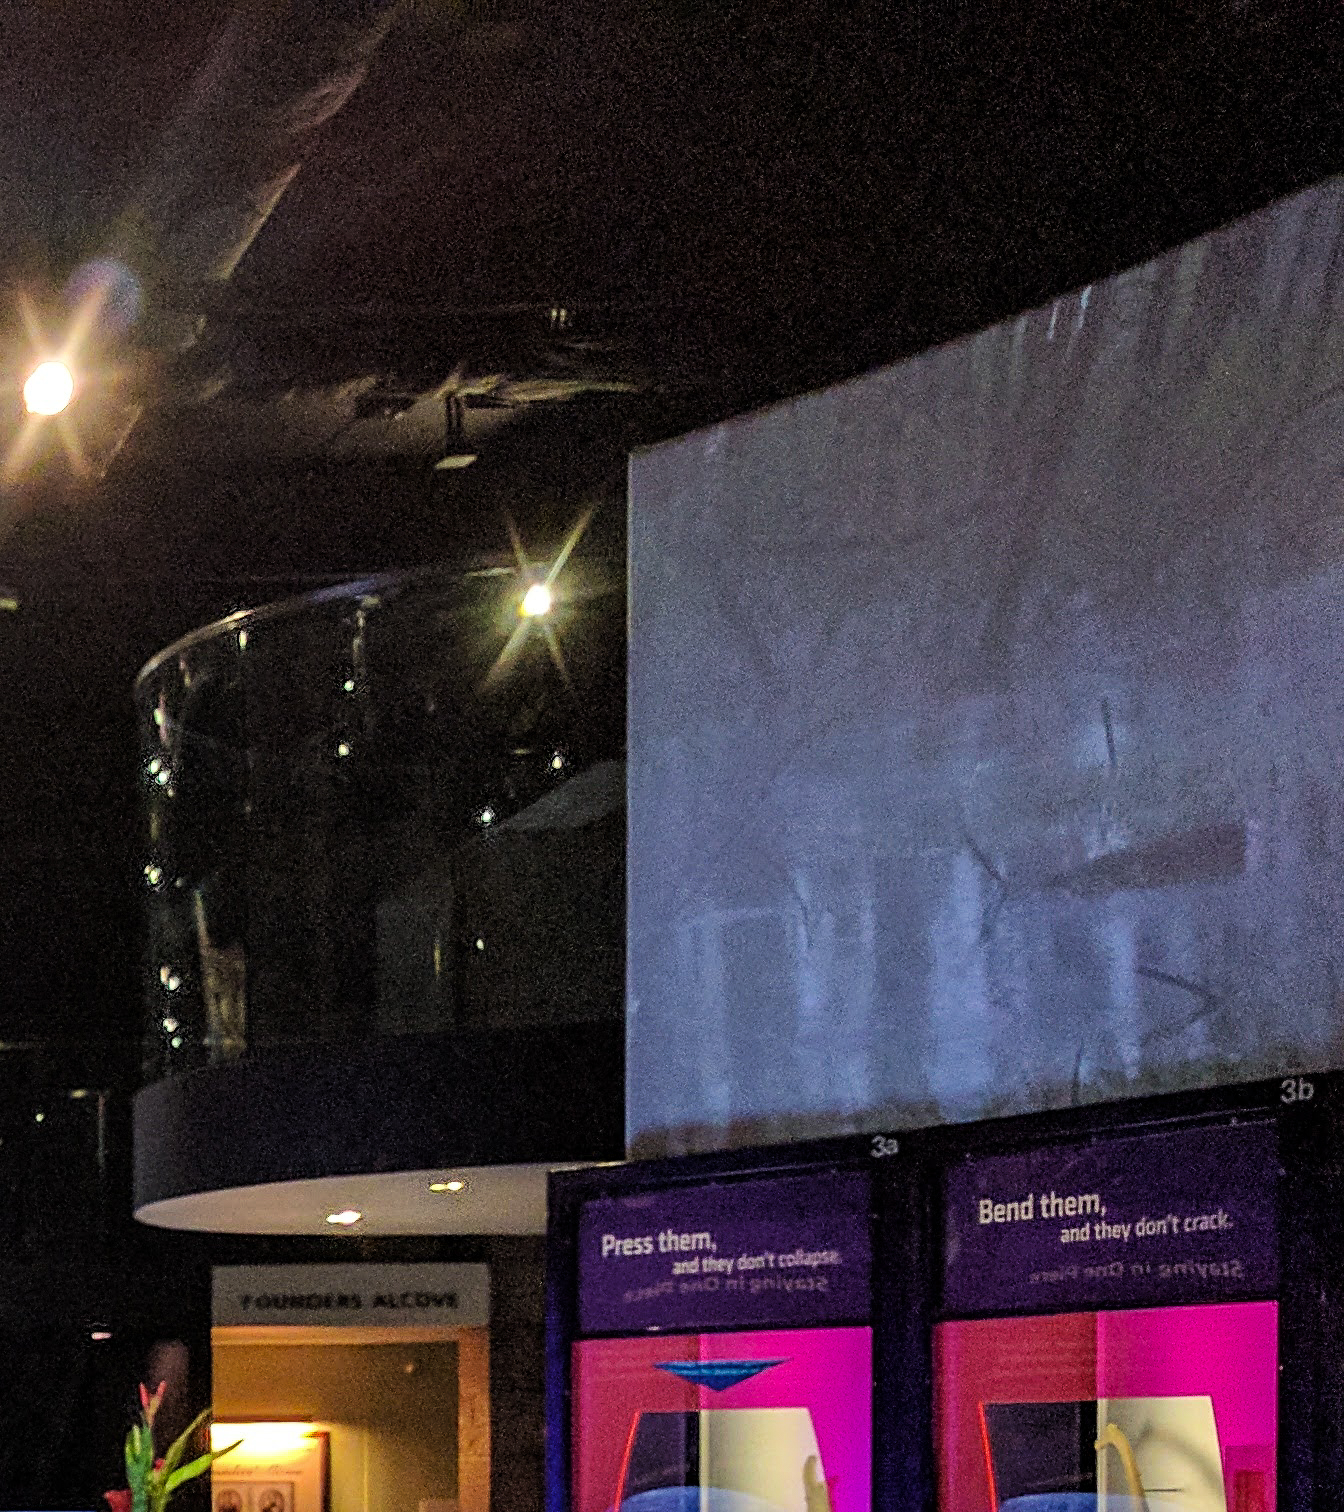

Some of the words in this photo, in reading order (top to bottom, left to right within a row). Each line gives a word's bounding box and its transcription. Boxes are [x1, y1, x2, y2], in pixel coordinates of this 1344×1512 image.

[1280, 1079, 1313, 1104] 3b
[870, 1135, 899, 1158] 3a
[978, 1194, 1033, 1224] Bend
[1040, 1191, 1107, 1216] them,
[1061, 1223, 1090, 1242] and
[1094, 1221, 1131, 1242] they
[1136, 1214, 1179, 1236] don't
[1184, 1209, 1233, 1232] crack.
[602, 1234, 654, 1257] Press
[658, 1229, 717, 1252] them,
[672, 1256, 699, 1275] and
[702, 1257, 734, 1275] they
[737, 1252, 775, 1270] don't
